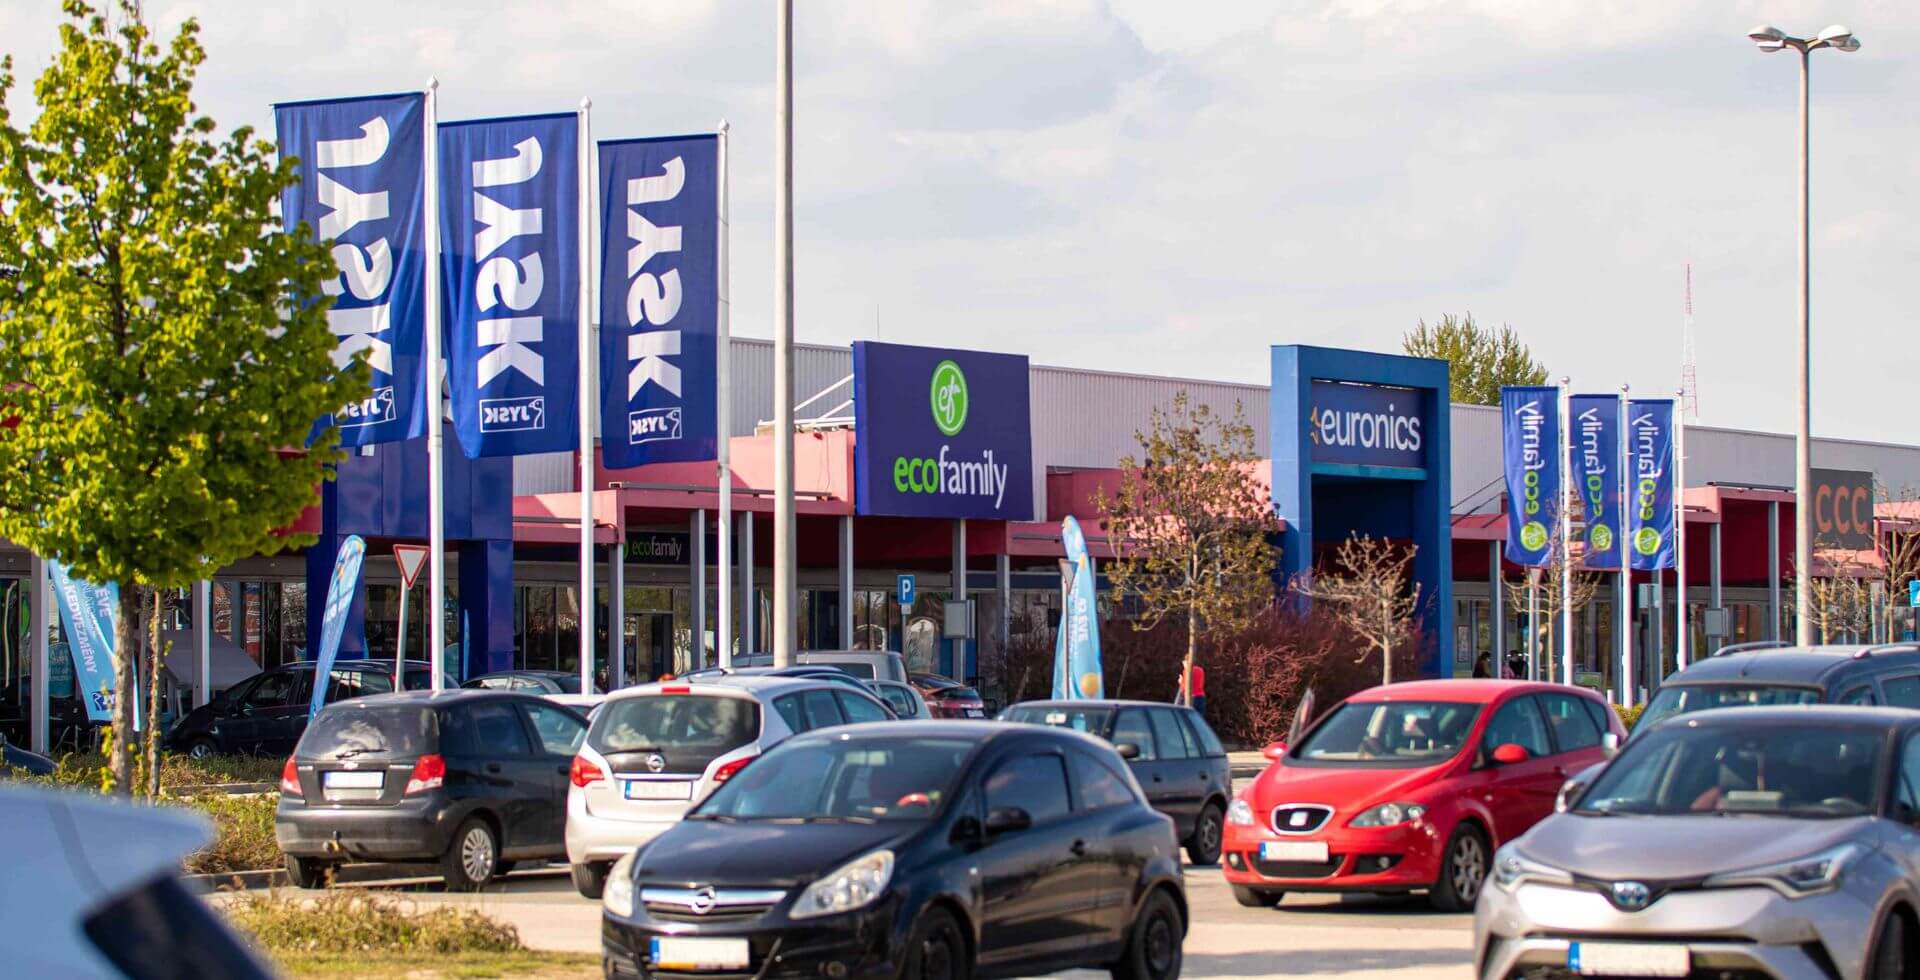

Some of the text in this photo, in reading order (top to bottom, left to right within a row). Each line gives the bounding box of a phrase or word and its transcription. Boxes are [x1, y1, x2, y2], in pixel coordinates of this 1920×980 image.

[1321, 404, 1421, 451] euronics
[893, 445, 1007, 509] ecofamily
[1815, 483, 1868, 534] CCC
[631, 536, 682, 560] ecofamily
[95, 589, 113, 618] ÉVE
[902, 579, 911, 600] P
[64, 586, 98, 674] KEDVEZMÉNY
